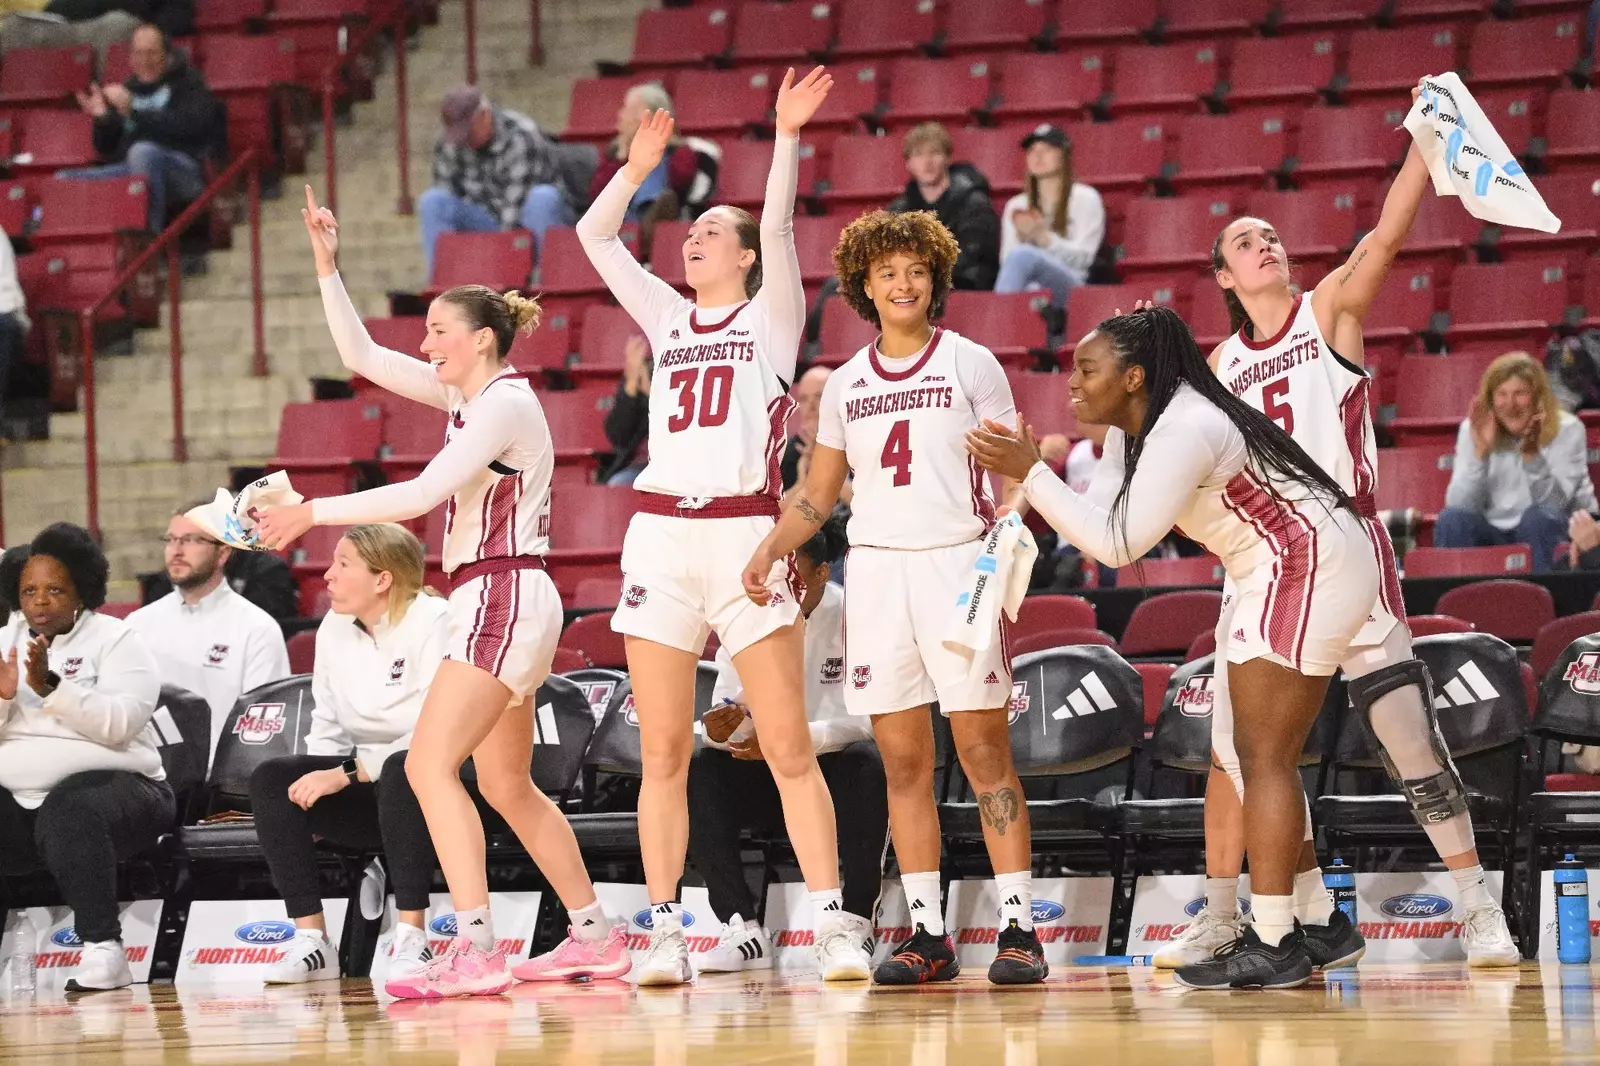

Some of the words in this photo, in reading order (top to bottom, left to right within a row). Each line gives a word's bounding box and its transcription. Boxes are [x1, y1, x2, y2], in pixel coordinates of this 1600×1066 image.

[1229, 338, 1319, 397] MASSACHUSETTS
[668, 365, 735, 433] 30
[845, 386, 953, 424] MASSACHUSETTS
[1262, 376, 1295, 438] 5
[880, 419, 913, 488] 4
[966, 574, 988, 625] POWERADE
[1176, 687, 1214, 705] MAS
[1394, 897, 1439, 915] Ford
[246, 924, 288, 941] Ford
